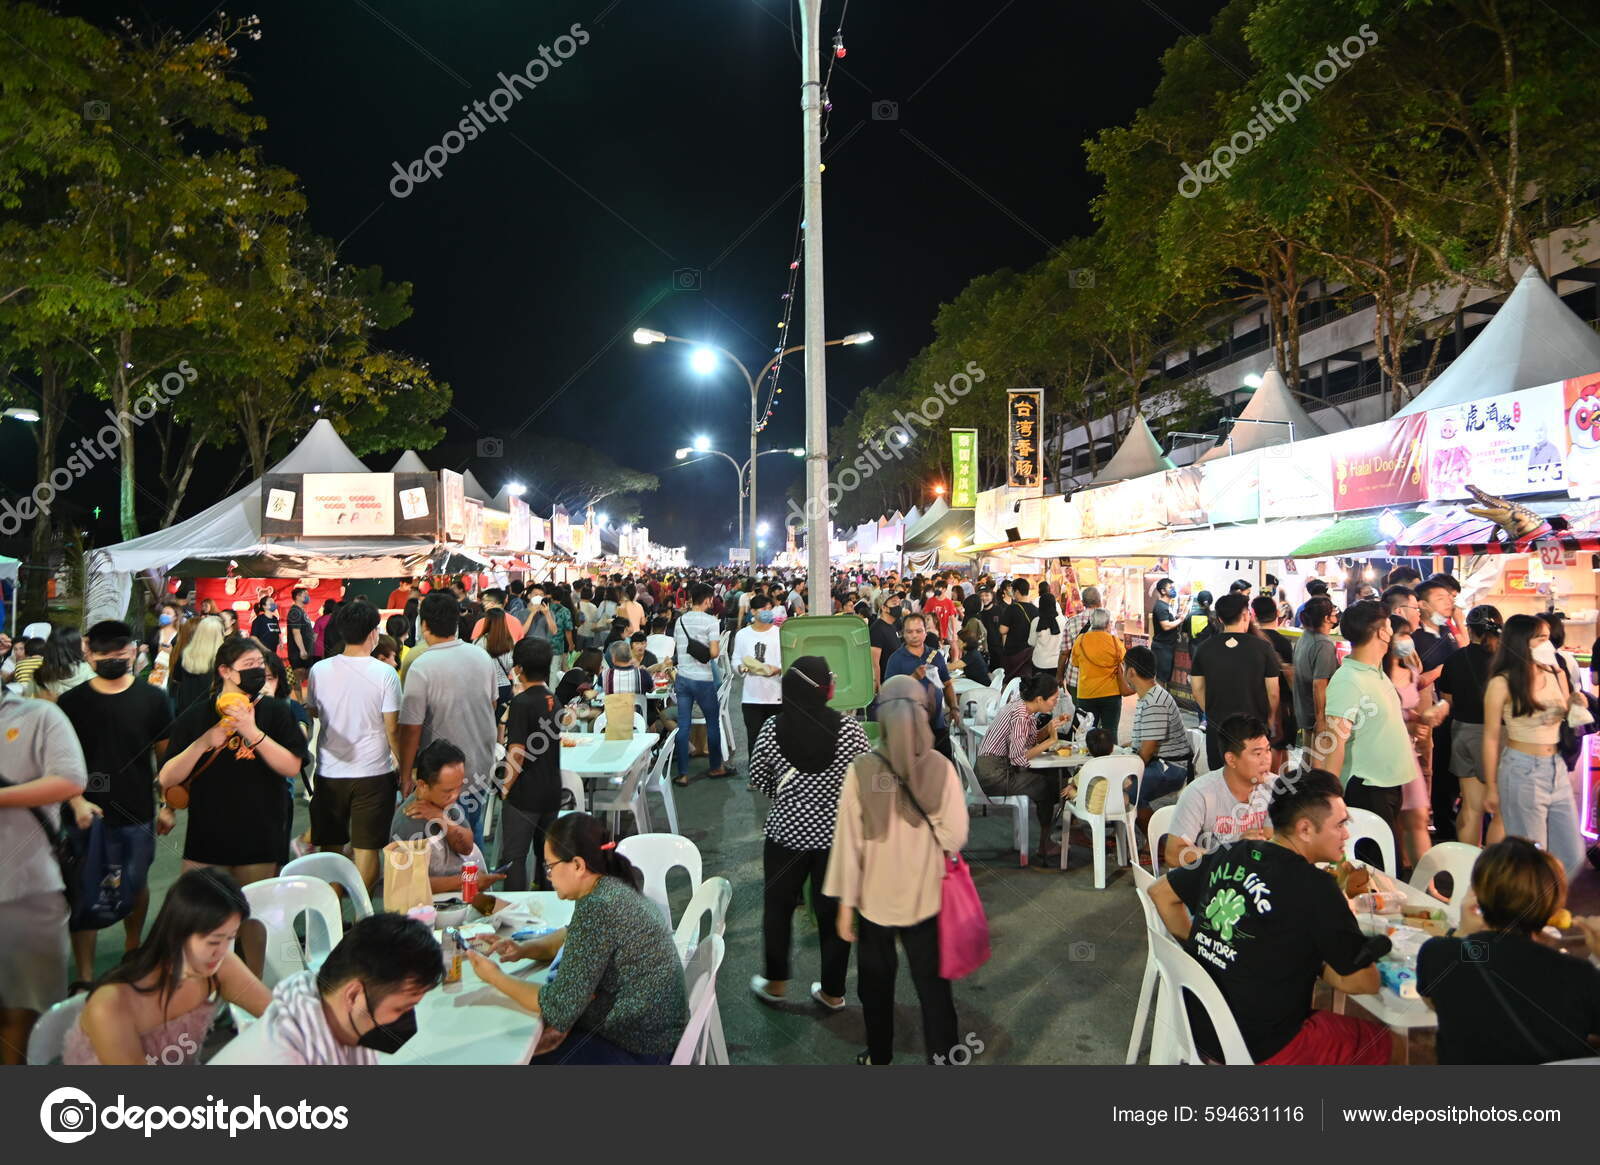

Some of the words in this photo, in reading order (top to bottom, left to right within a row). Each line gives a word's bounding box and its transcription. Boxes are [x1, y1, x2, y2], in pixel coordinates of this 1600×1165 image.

[1540, 546, 1562, 565] 82
[1209, 862, 1246, 888] MLB
[1195, 932, 1212, 947] NEW
[1212, 940, 1237, 961] YORK
